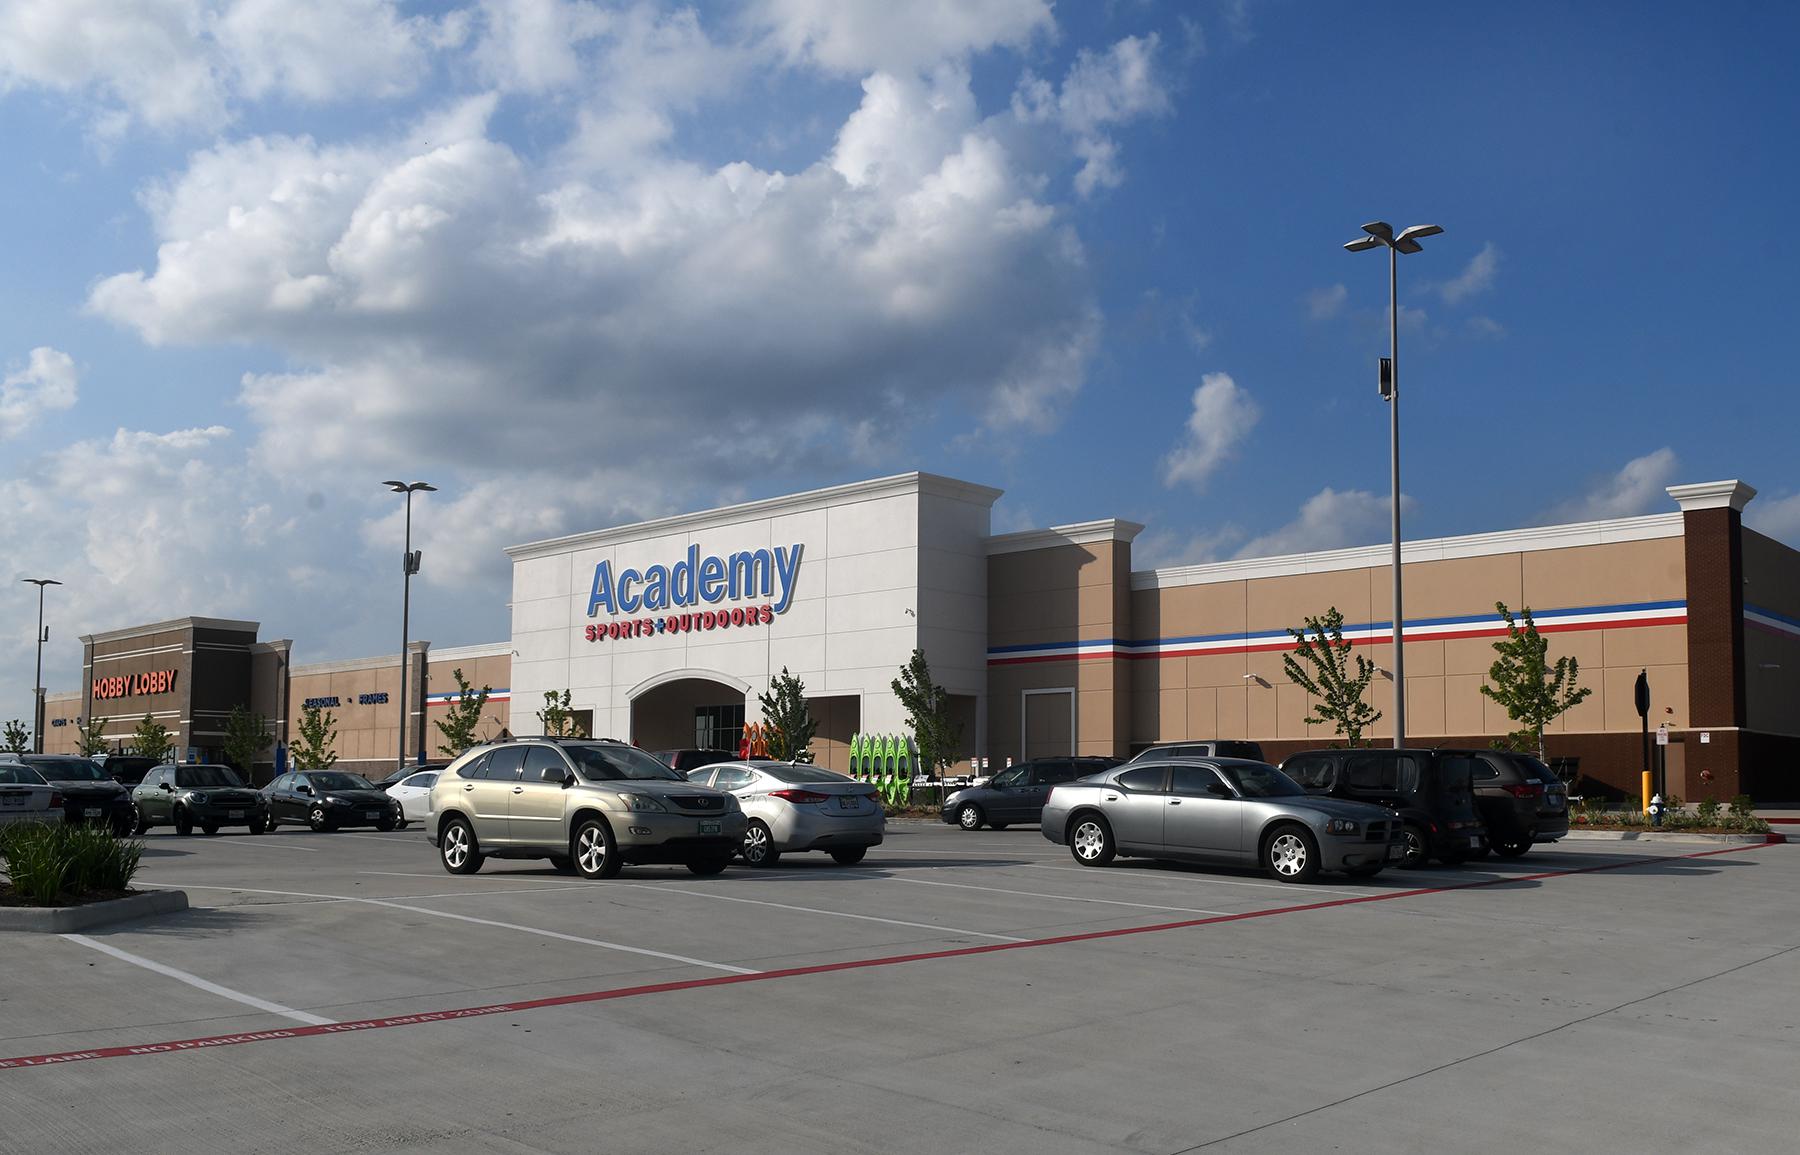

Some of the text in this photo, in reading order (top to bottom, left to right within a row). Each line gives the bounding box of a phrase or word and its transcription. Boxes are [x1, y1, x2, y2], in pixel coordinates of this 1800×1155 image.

[586, 542, 804, 617] Academy
[93, 669, 177, 700] HOBBY LOBBY
[304, 693, 389, 709] SEASONAL FRAMES
[24, 1052, 102, 1065] LANE
[129, 1045, 172, 1055] NO
[176, 1031, 296, 1049] PARKING
[319, 1022, 377, 1032] TOW
[384, 1013, 448, 1026] AWAY
[450, 1004, 513, 1017] ZONE
